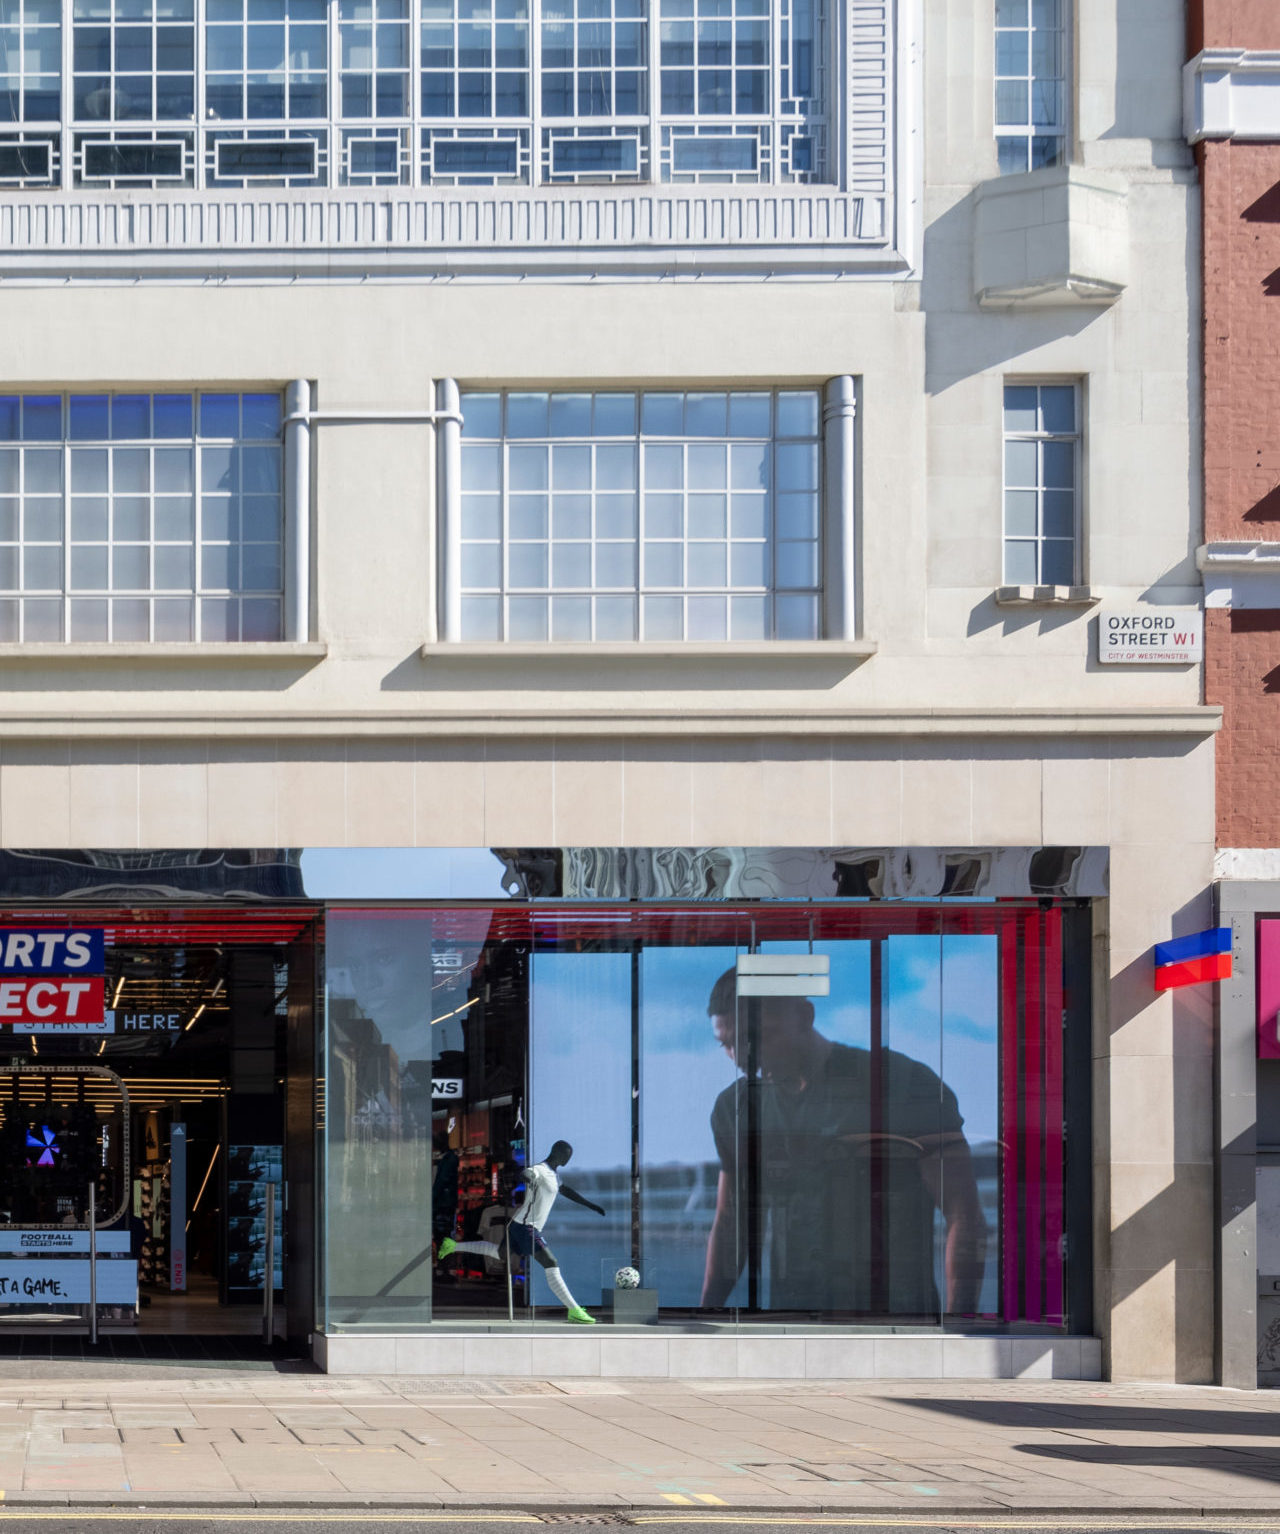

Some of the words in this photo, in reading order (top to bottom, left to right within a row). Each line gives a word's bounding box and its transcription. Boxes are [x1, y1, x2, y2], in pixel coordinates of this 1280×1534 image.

[1108, 617, 1175, 629] OXFORD
[1108, 633, 1168, 645] STREET
[1173, 633, 1195, 645] W1
[124, 1014, 180, 1030] HERE
[11, 1280, 19, 1294] A
[23, 1277, 68, 1298] GAME.
